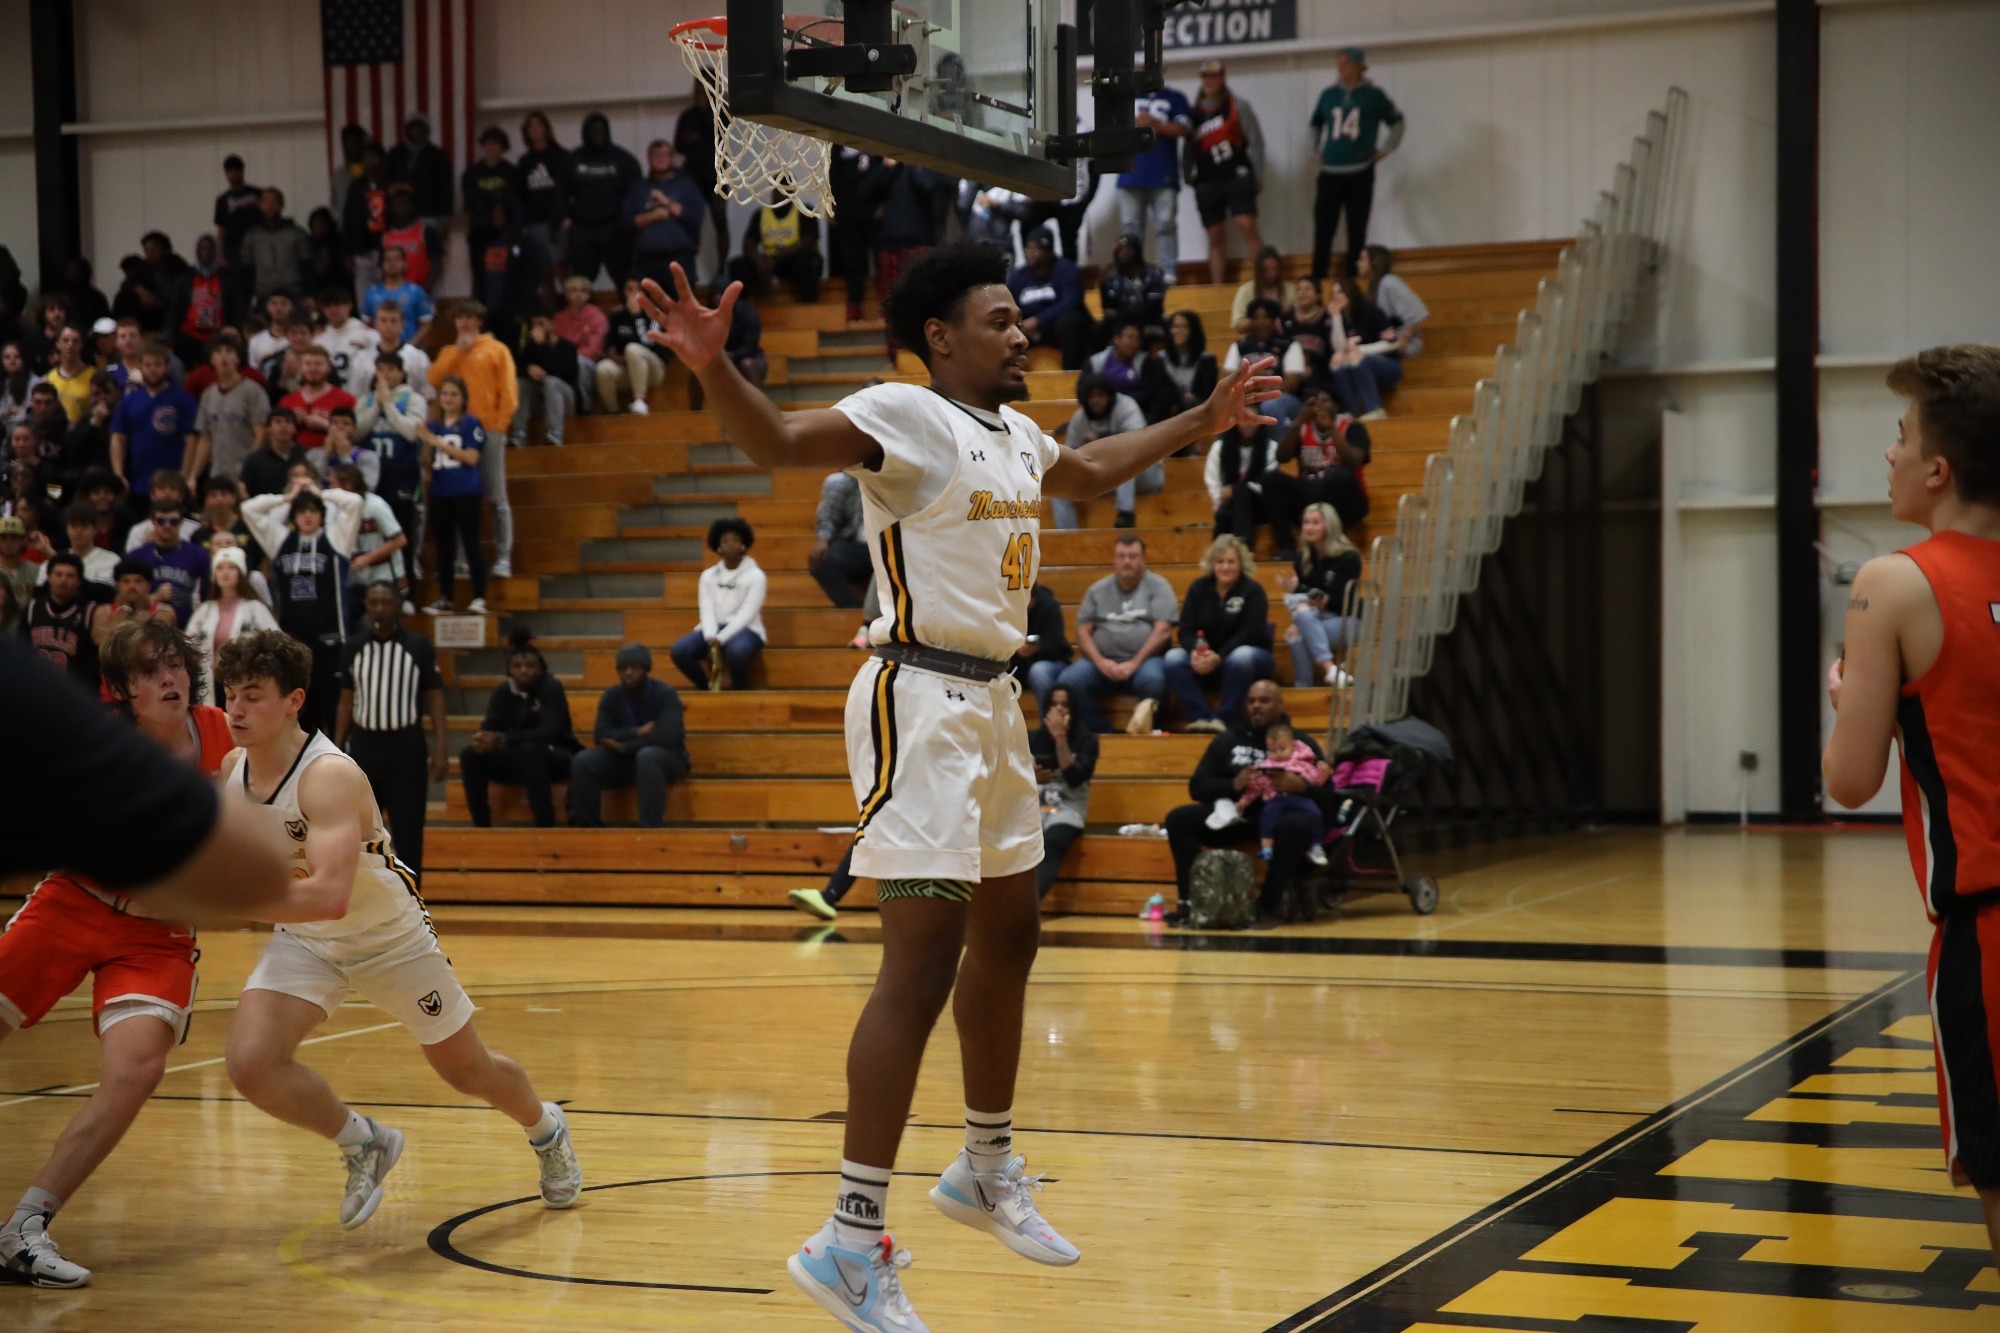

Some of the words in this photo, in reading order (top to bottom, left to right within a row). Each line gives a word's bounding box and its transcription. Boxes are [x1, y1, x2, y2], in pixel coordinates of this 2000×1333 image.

[1162, 8, 1272, 46] ECTION
[1330, 106, 1361, 142] 14
[1210, 139, 1233, 165] 13
